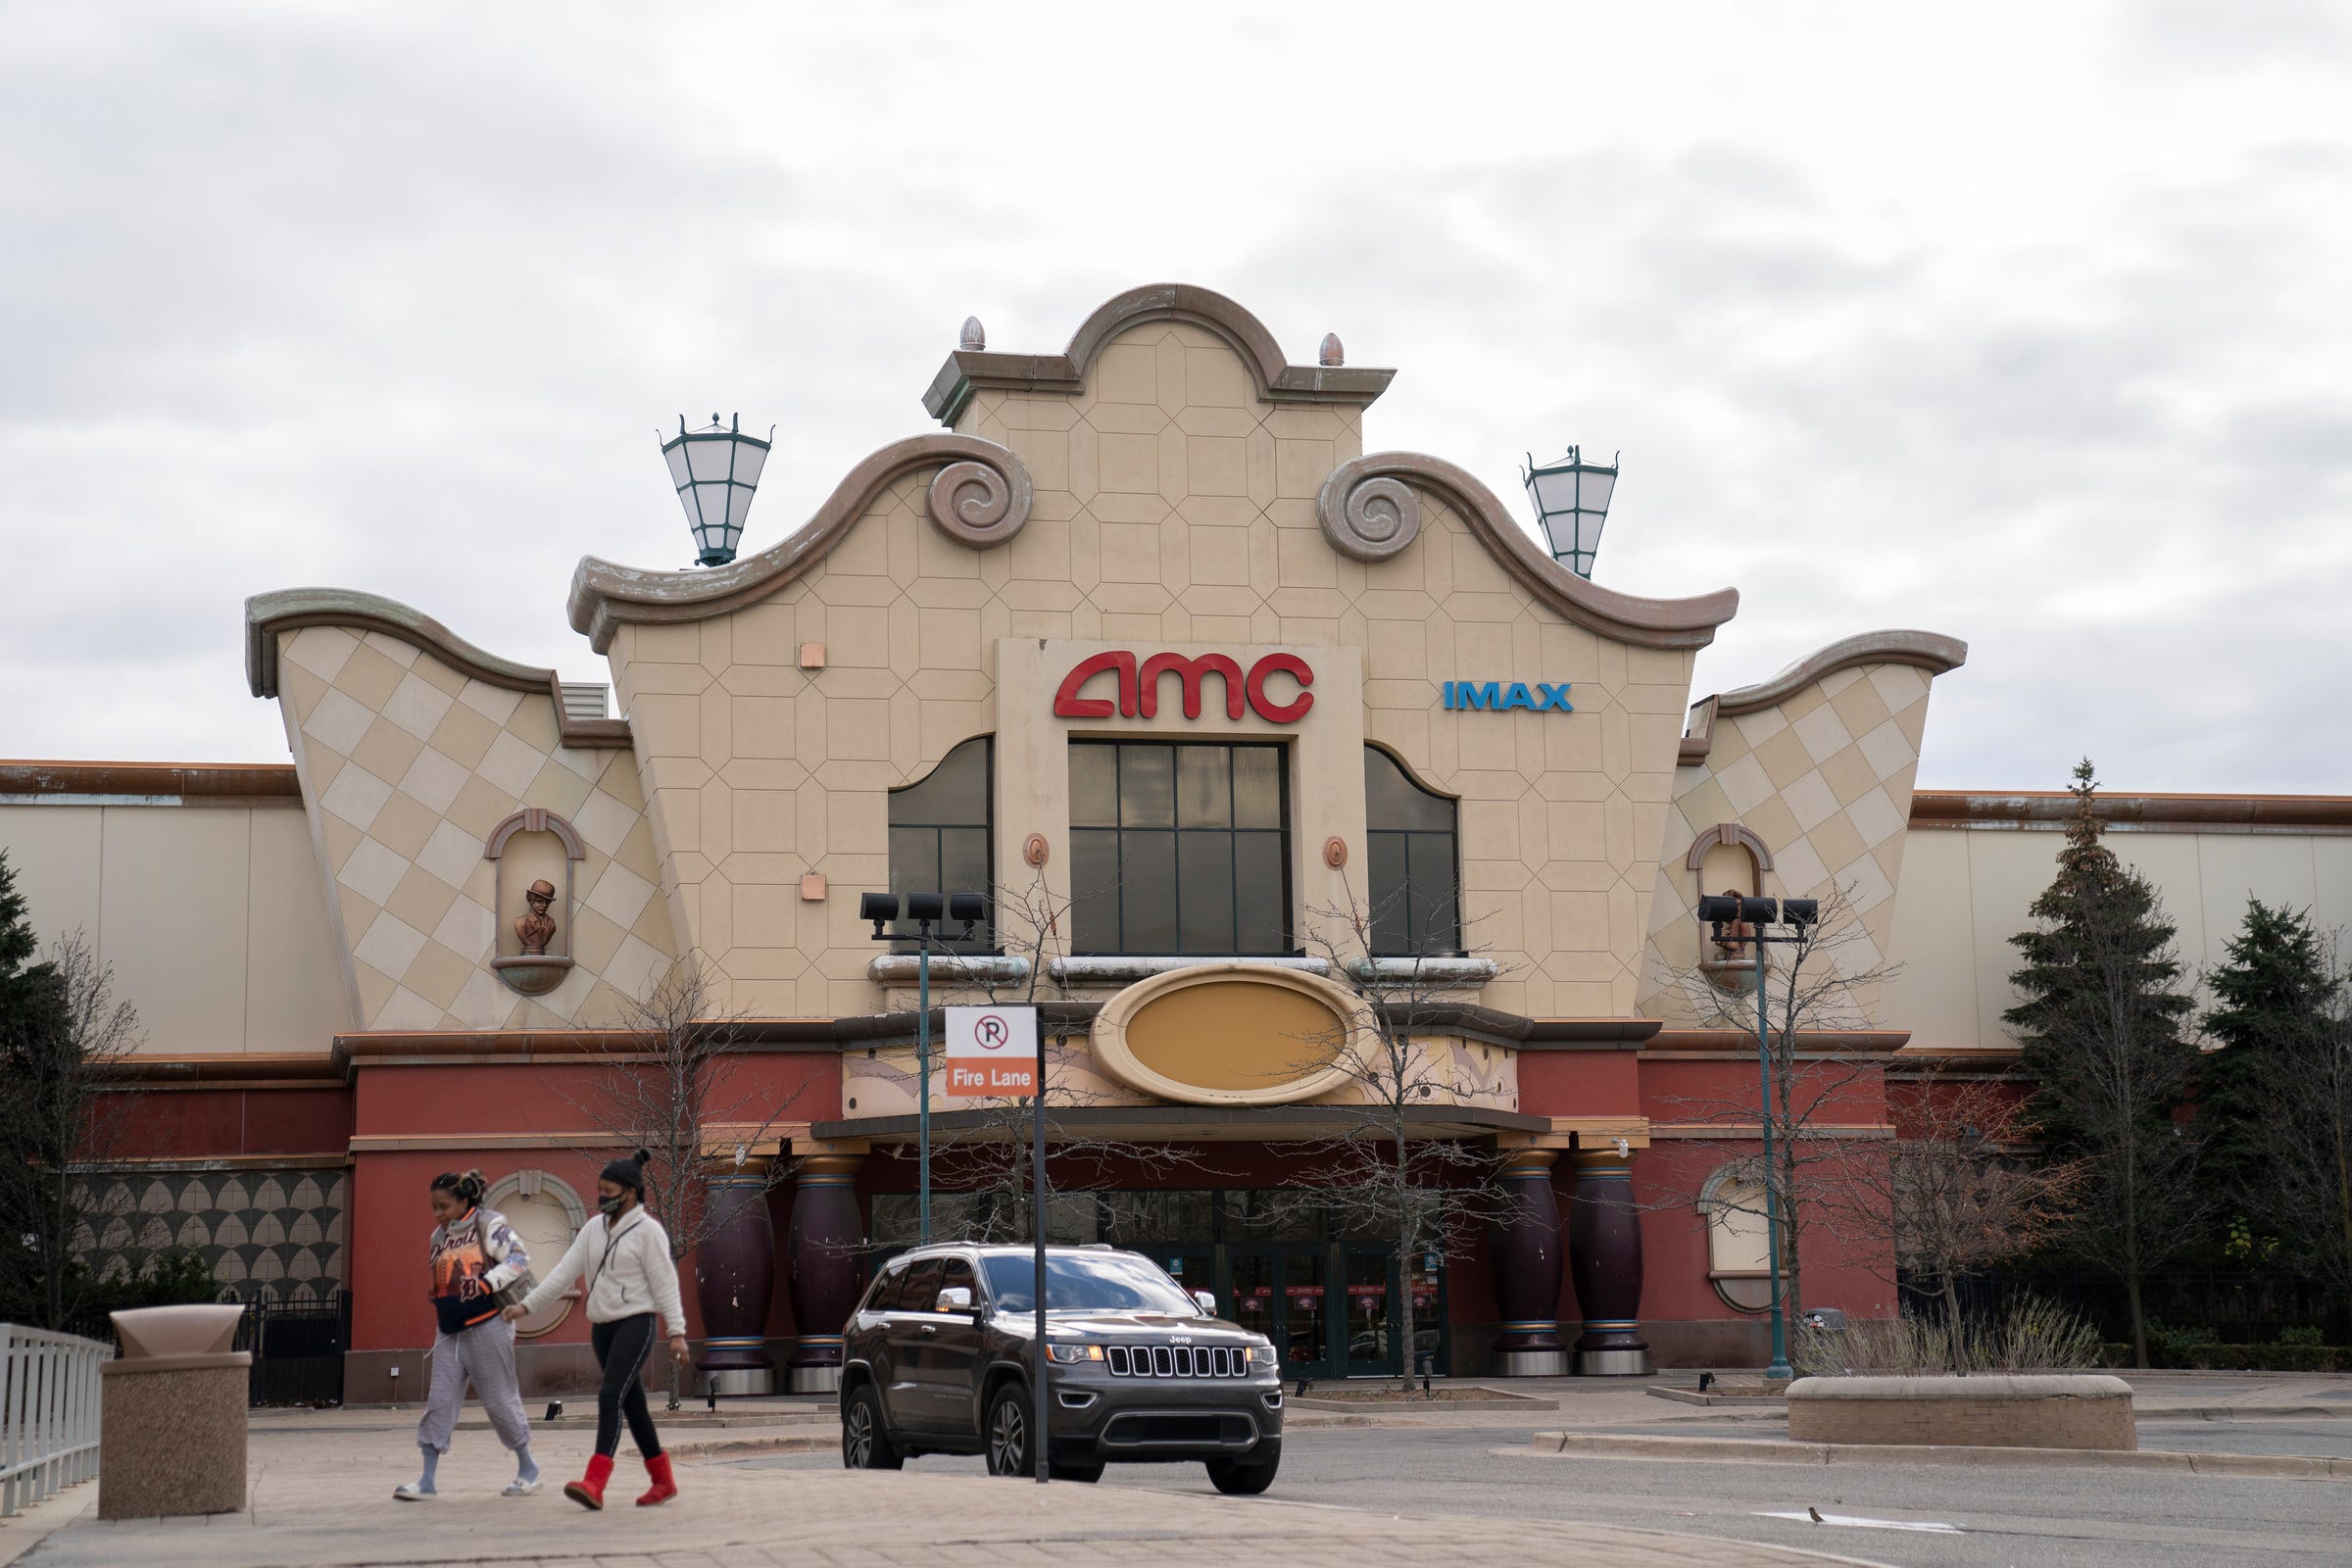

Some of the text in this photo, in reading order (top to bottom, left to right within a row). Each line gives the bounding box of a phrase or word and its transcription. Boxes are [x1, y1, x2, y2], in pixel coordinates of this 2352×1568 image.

[1444, 681, 1574, 711] IMAX
[954, 1069, 1031, 1087] Fire Lane
[430, 1227, 478, 1264] Dtroit
[1169, 1335, 1192, 1345] Jeep
